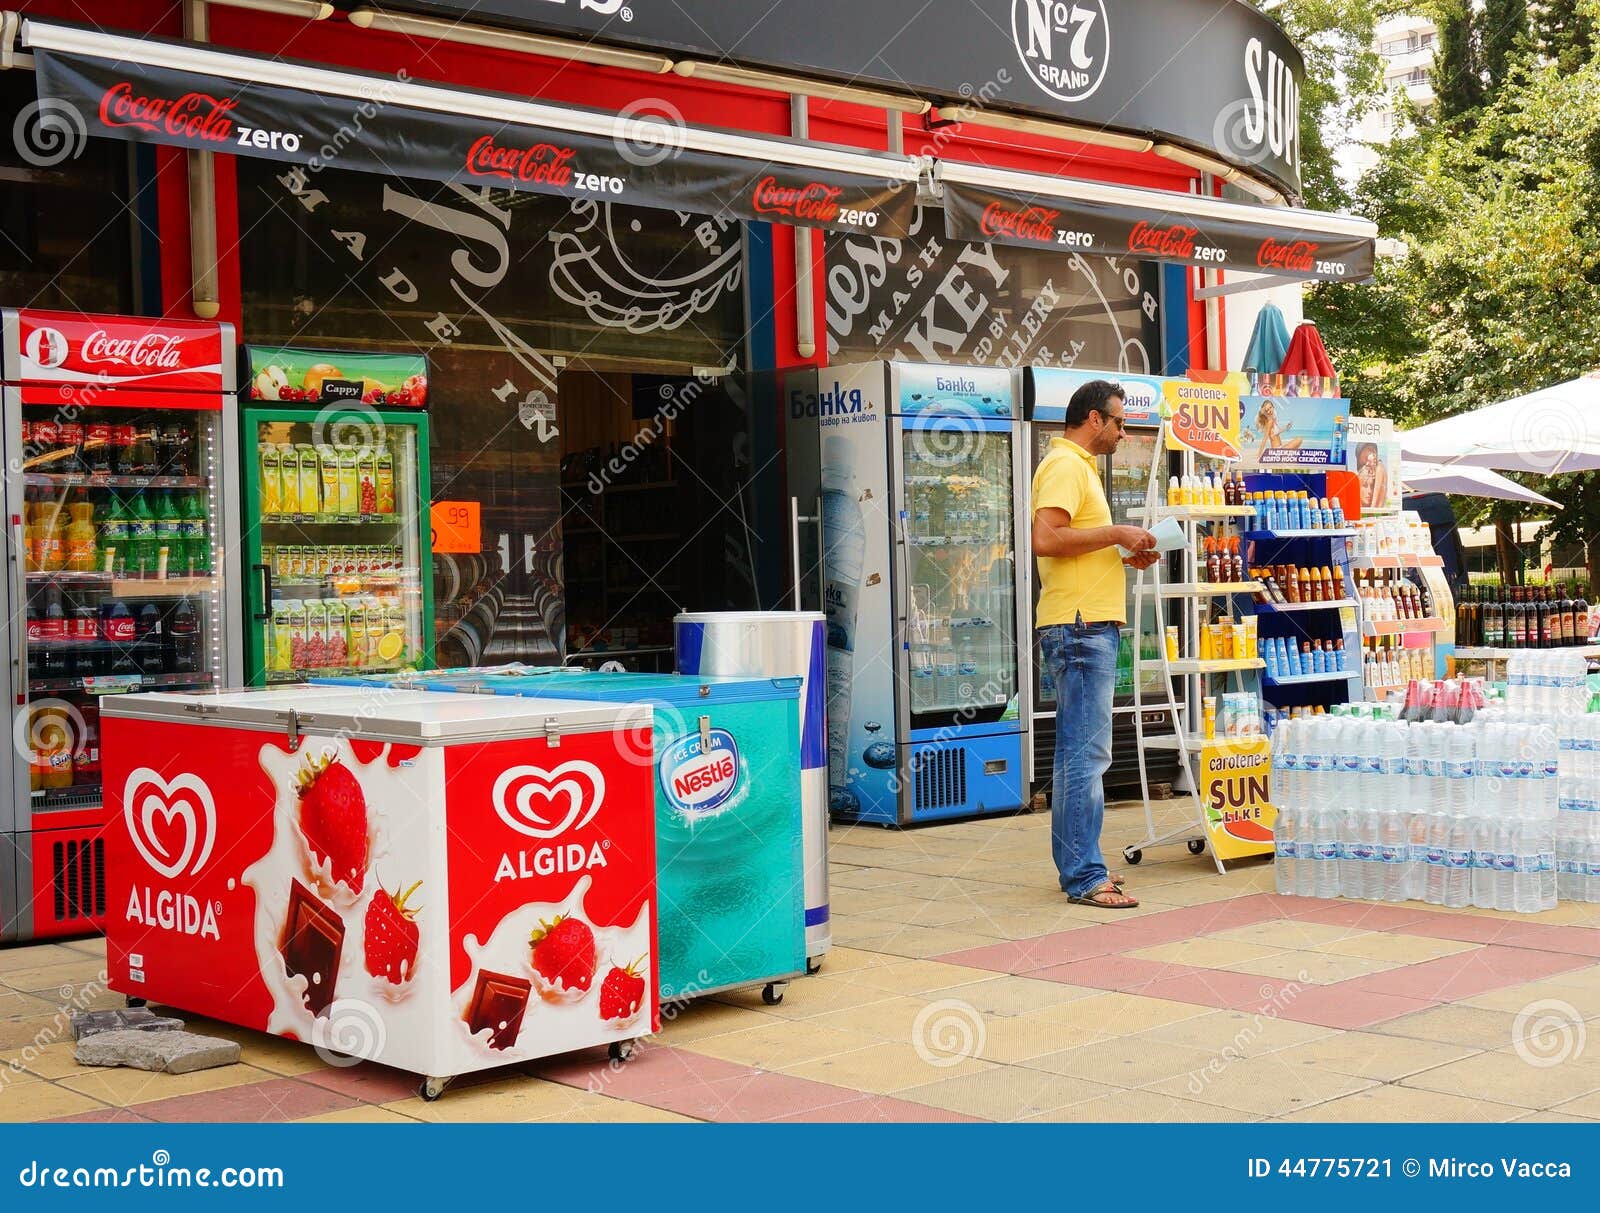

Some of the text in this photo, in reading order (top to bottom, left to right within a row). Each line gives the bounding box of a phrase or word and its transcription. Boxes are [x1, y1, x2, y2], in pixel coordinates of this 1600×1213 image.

[1039, 62, 1090, 90] BRAND
[100, 81, 300, 152] Coca-Cola zero
[1244, 37, 1300, 180] SUP
[466, 135, 623, 194] Coca-Cola zero
[752, 176, 877, 228] Coca-Cola zero
[980, 201, 1093, 248] Coca-Cola zero
[1128, 219, 1225, 263] Coca-Cola zero
[1256, 237, 1346, 276] Coca-Cola zero
[868, 236, 944, 345] MASH
[893, 242, 1010, 364] KEY
[988, 311, 1008, 340] BY
[81, 330, 186, 368] Coca-Cola
[325, 383, 360, 397] Cappy
[791, 381, 861, 419] Банкя
[936, 376, 975, 392] Банкя
[1178, 387, 1227, 400] carotene+
[841, 416, 850, 424] на
[851, 413, 877, 423] живот
[1179, 403, 1229, 430] SUN
[1189, 431, 1221, 441] LIKE
[674, 747, 688, 762] ICE
[1209, 754, 1268, 771] carotene+
[1210, 774, 1269, 809] SUN
[1225, 807, 1261, 822] LIKE
[495, 841, 608, 882] ALGIDA
[126, 883, 220, 941] ALGIDA
